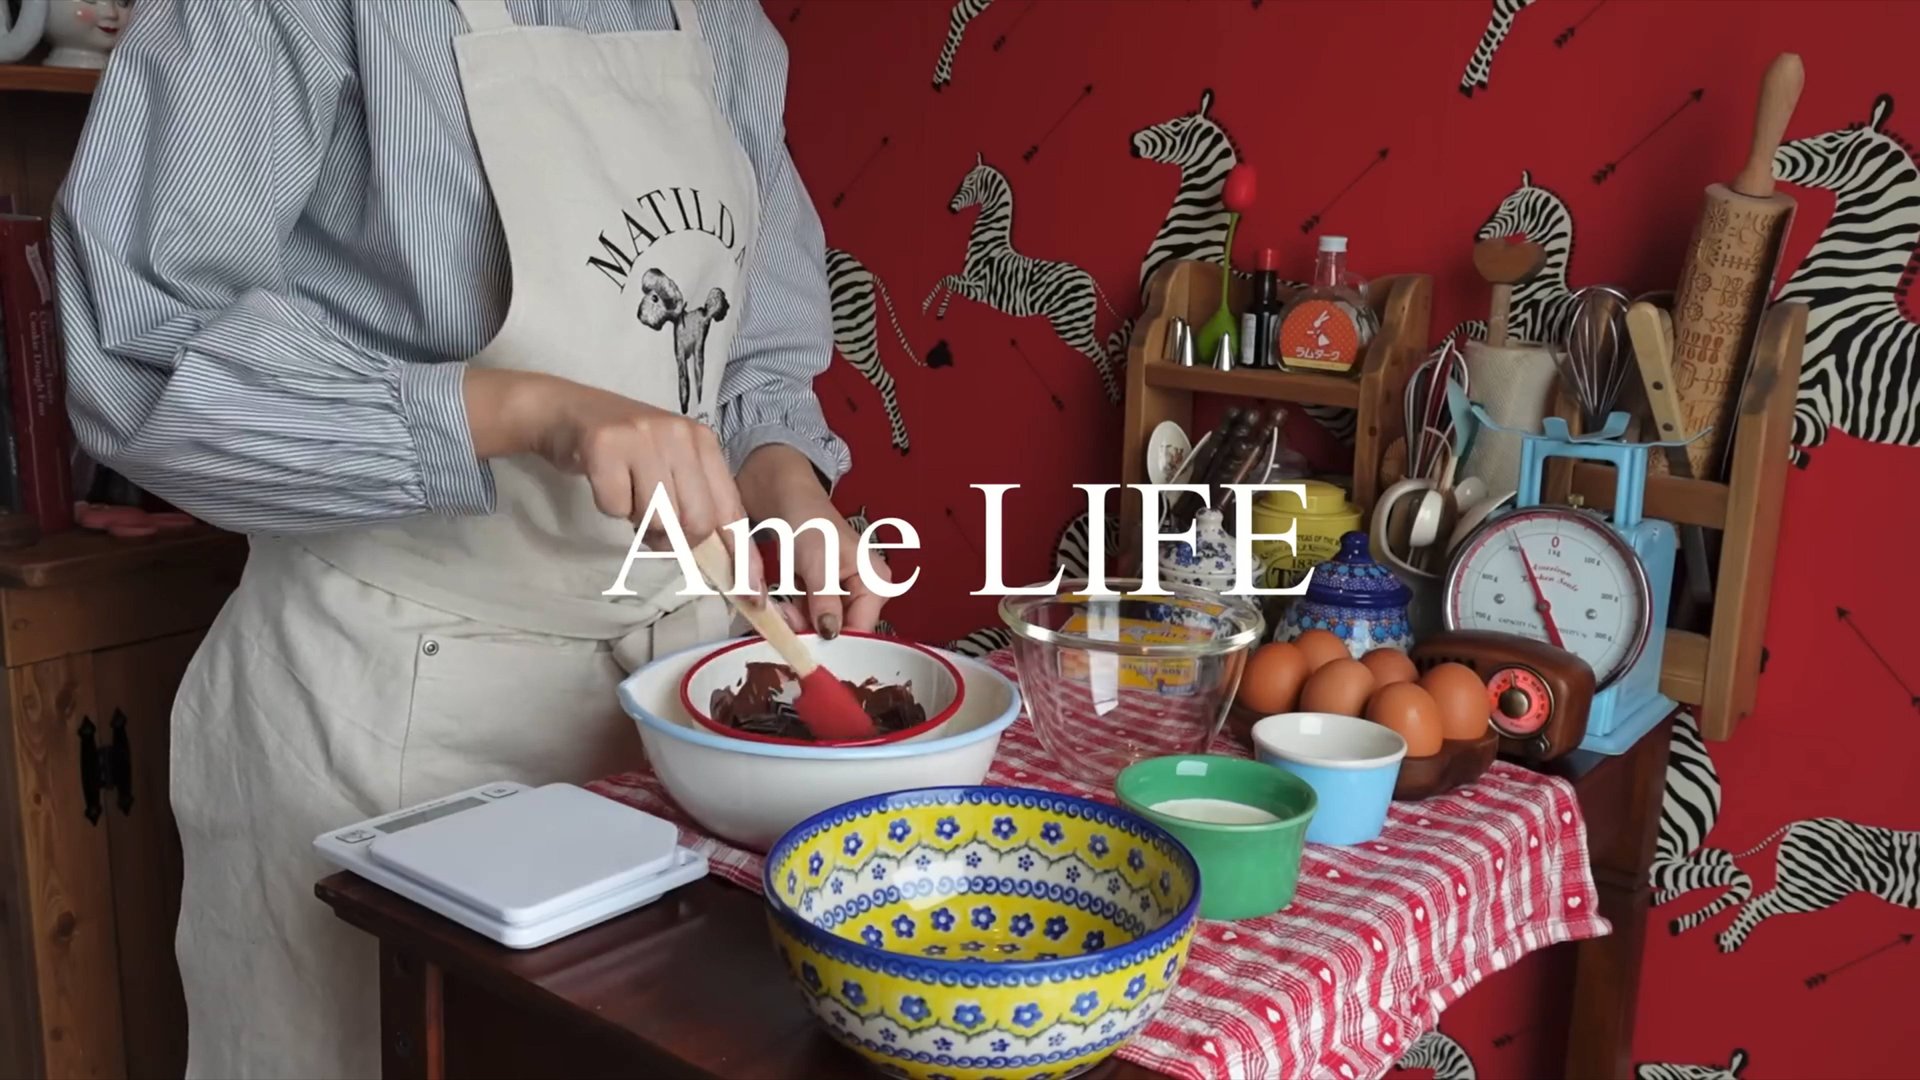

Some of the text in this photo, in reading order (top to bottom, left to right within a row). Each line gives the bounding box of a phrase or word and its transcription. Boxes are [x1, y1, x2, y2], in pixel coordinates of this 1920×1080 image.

[29, 310, 46, 417] Cookie Dough Fun
[1551, 536, 1560, 548] 0
[1533, 563, 1572, 578] American
